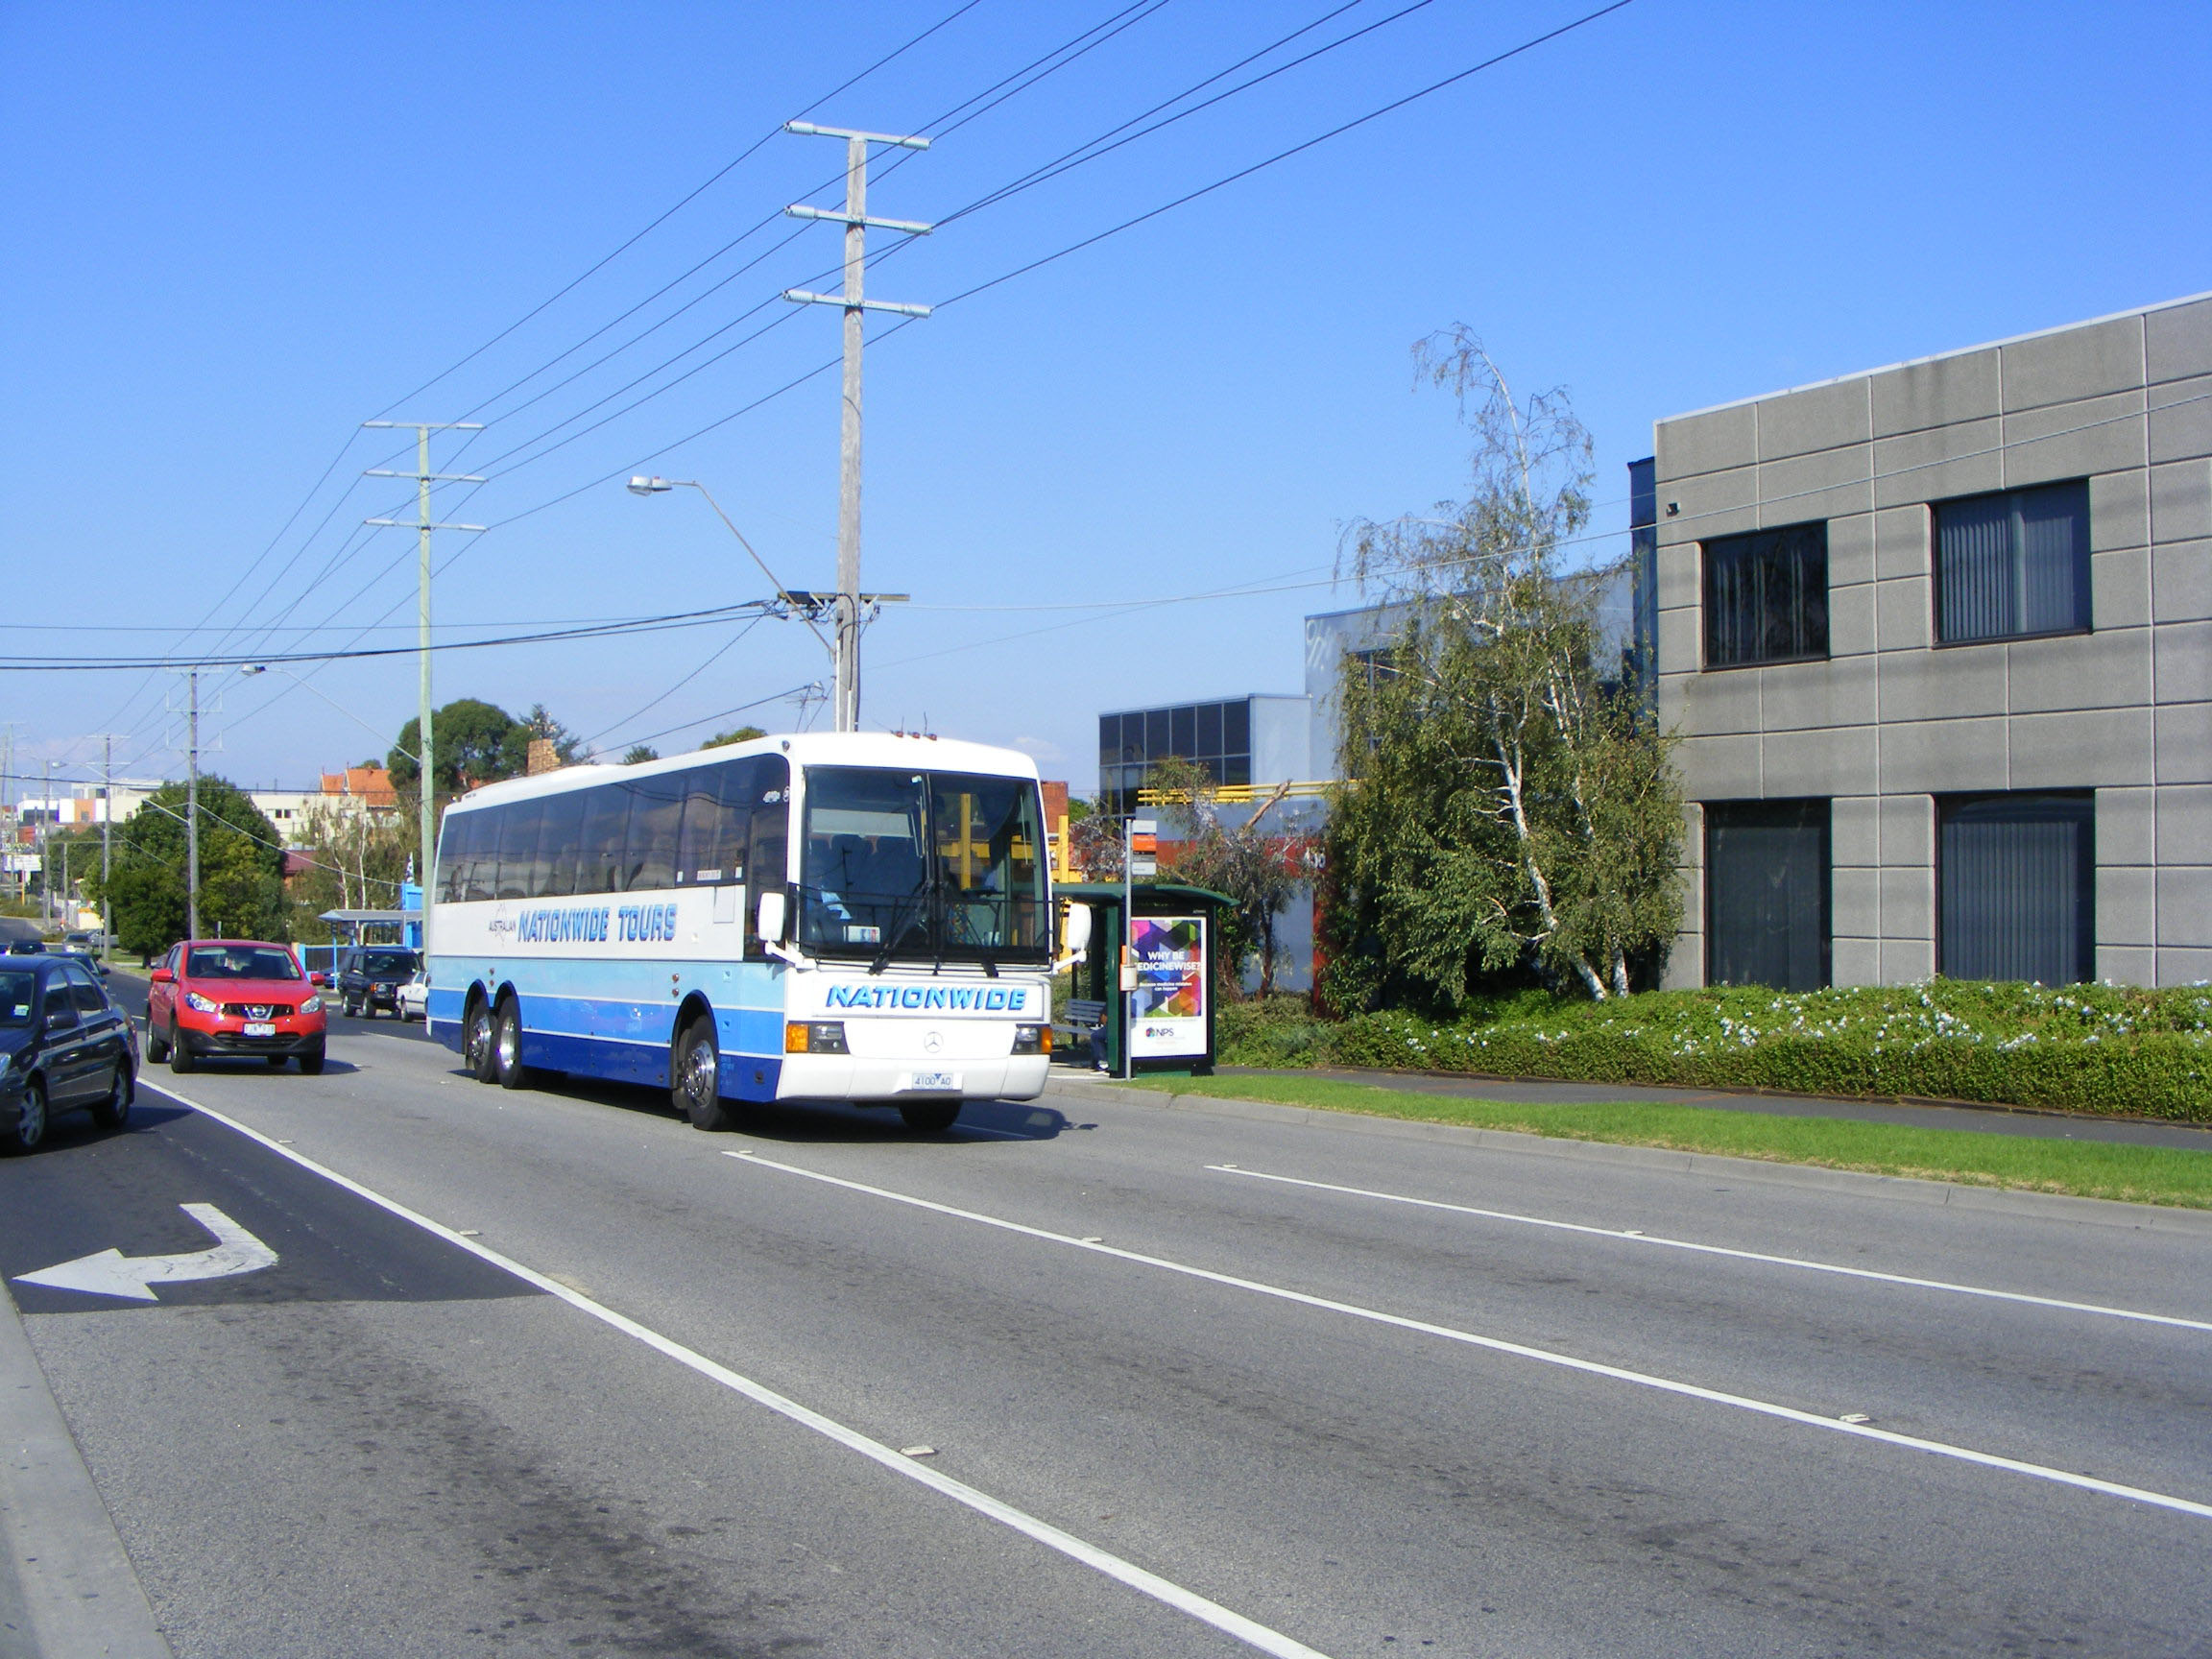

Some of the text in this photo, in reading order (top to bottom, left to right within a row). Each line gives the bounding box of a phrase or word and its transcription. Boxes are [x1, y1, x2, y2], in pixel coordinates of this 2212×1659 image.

[488, 902, 678, 942] AUSTRALIAN NATIONWIDE TOURS
[1147, 950, 1185, 960] WHY BE
[1134, 961, 1201, 972] EDICINEWISE?
[826, 984, 1026, 1011] NATIONWIDE
[1156, 1027, 1174, 1037] NPS
[914, 1076, 936, 1086] 4100
